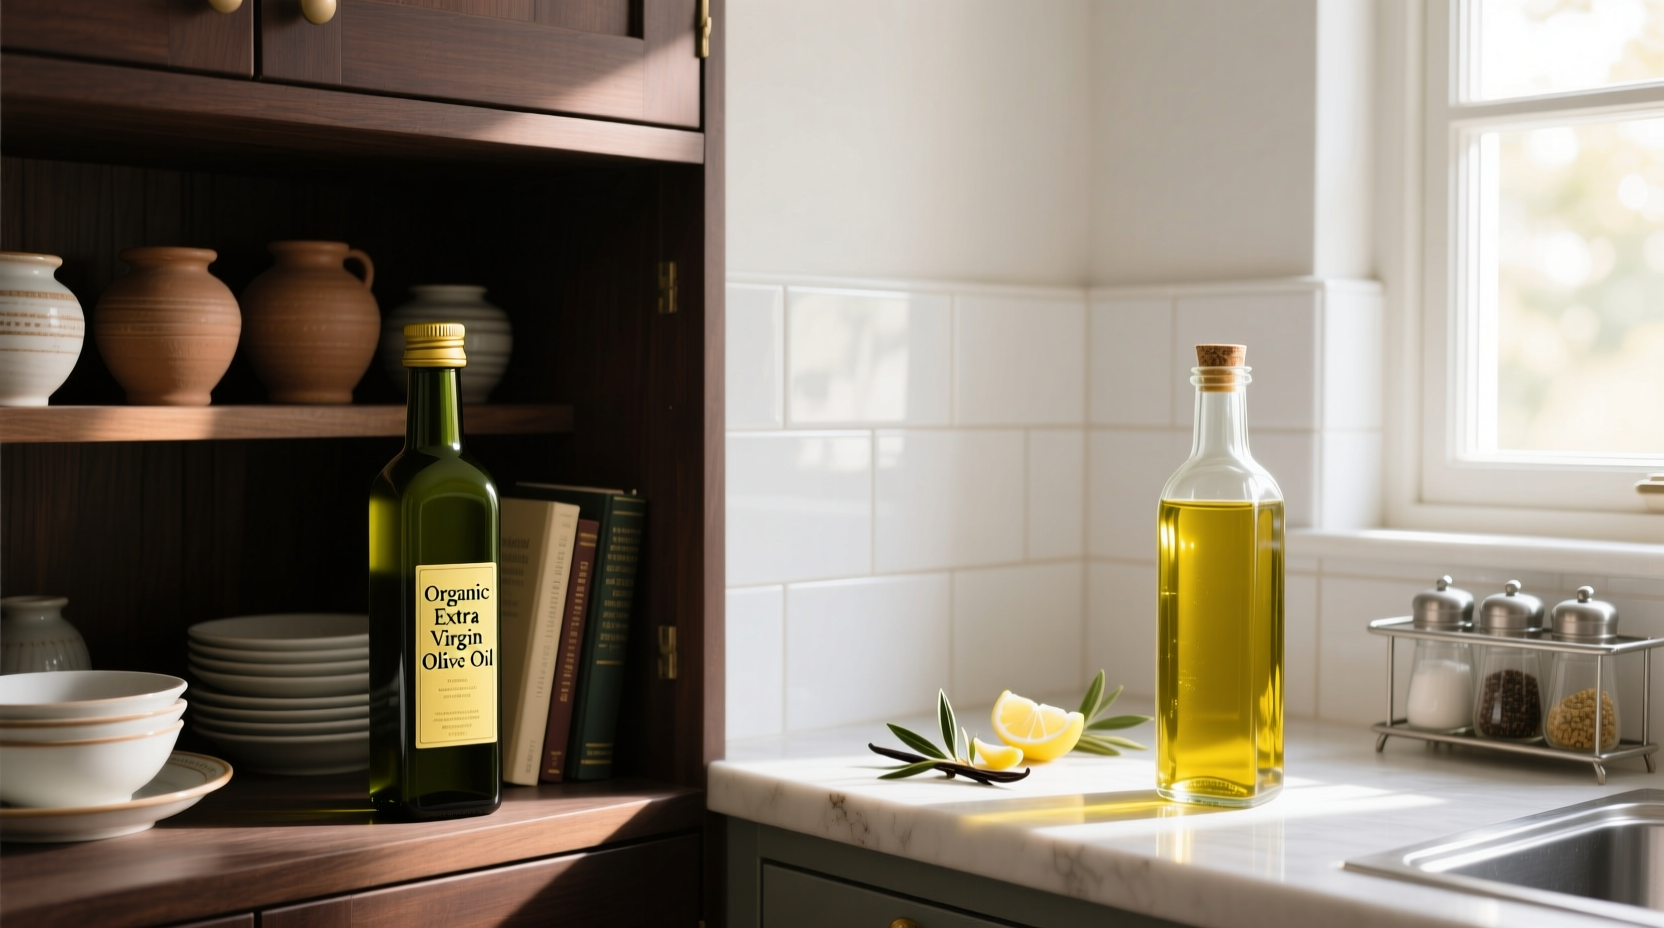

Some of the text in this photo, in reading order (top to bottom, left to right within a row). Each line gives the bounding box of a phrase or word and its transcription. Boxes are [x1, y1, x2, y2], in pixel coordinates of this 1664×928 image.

[424, 583, 490, 607] Organic
[434, 607, 480, 625] Extra
[430, 629, 483, 651] Virgin
[422, 648, 493, 670] Olive Oil
